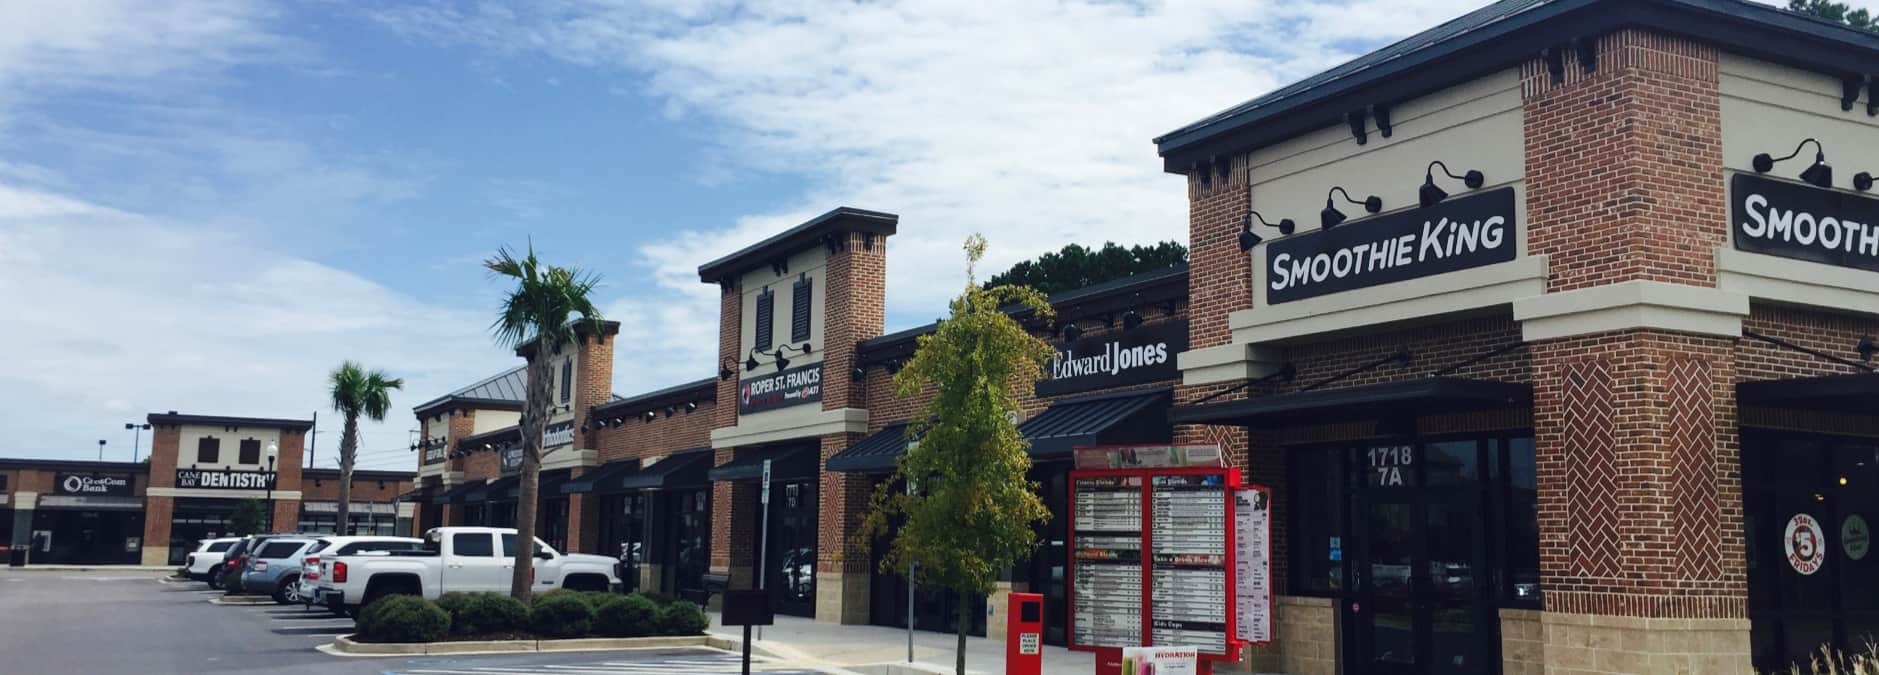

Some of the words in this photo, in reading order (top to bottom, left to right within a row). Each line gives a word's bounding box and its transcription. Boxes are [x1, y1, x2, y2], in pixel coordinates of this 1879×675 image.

[1271, 234, 1416, 290] SMOOTHIE
[1053, 342, 1110, 380] Edward
[1111, 341, 1168, 375] Jones
[750, 378, 775, 396] ROPER
[775, 374, 786, 391] ST.
[786, 367, 820, 389] FRANCIS
[1367, 446, 1412, 466] 1718
[178, 471, 200, 479] CANE
[201, 472, 275, 488] DENTISTRY
[1377, 466, 1402, 486] 7A
[82, 484, 108, 492] Bank
[1789, 552, 1823, 573] FRIDAYS
[1155, 651, 1196, 659] HYDRATION
